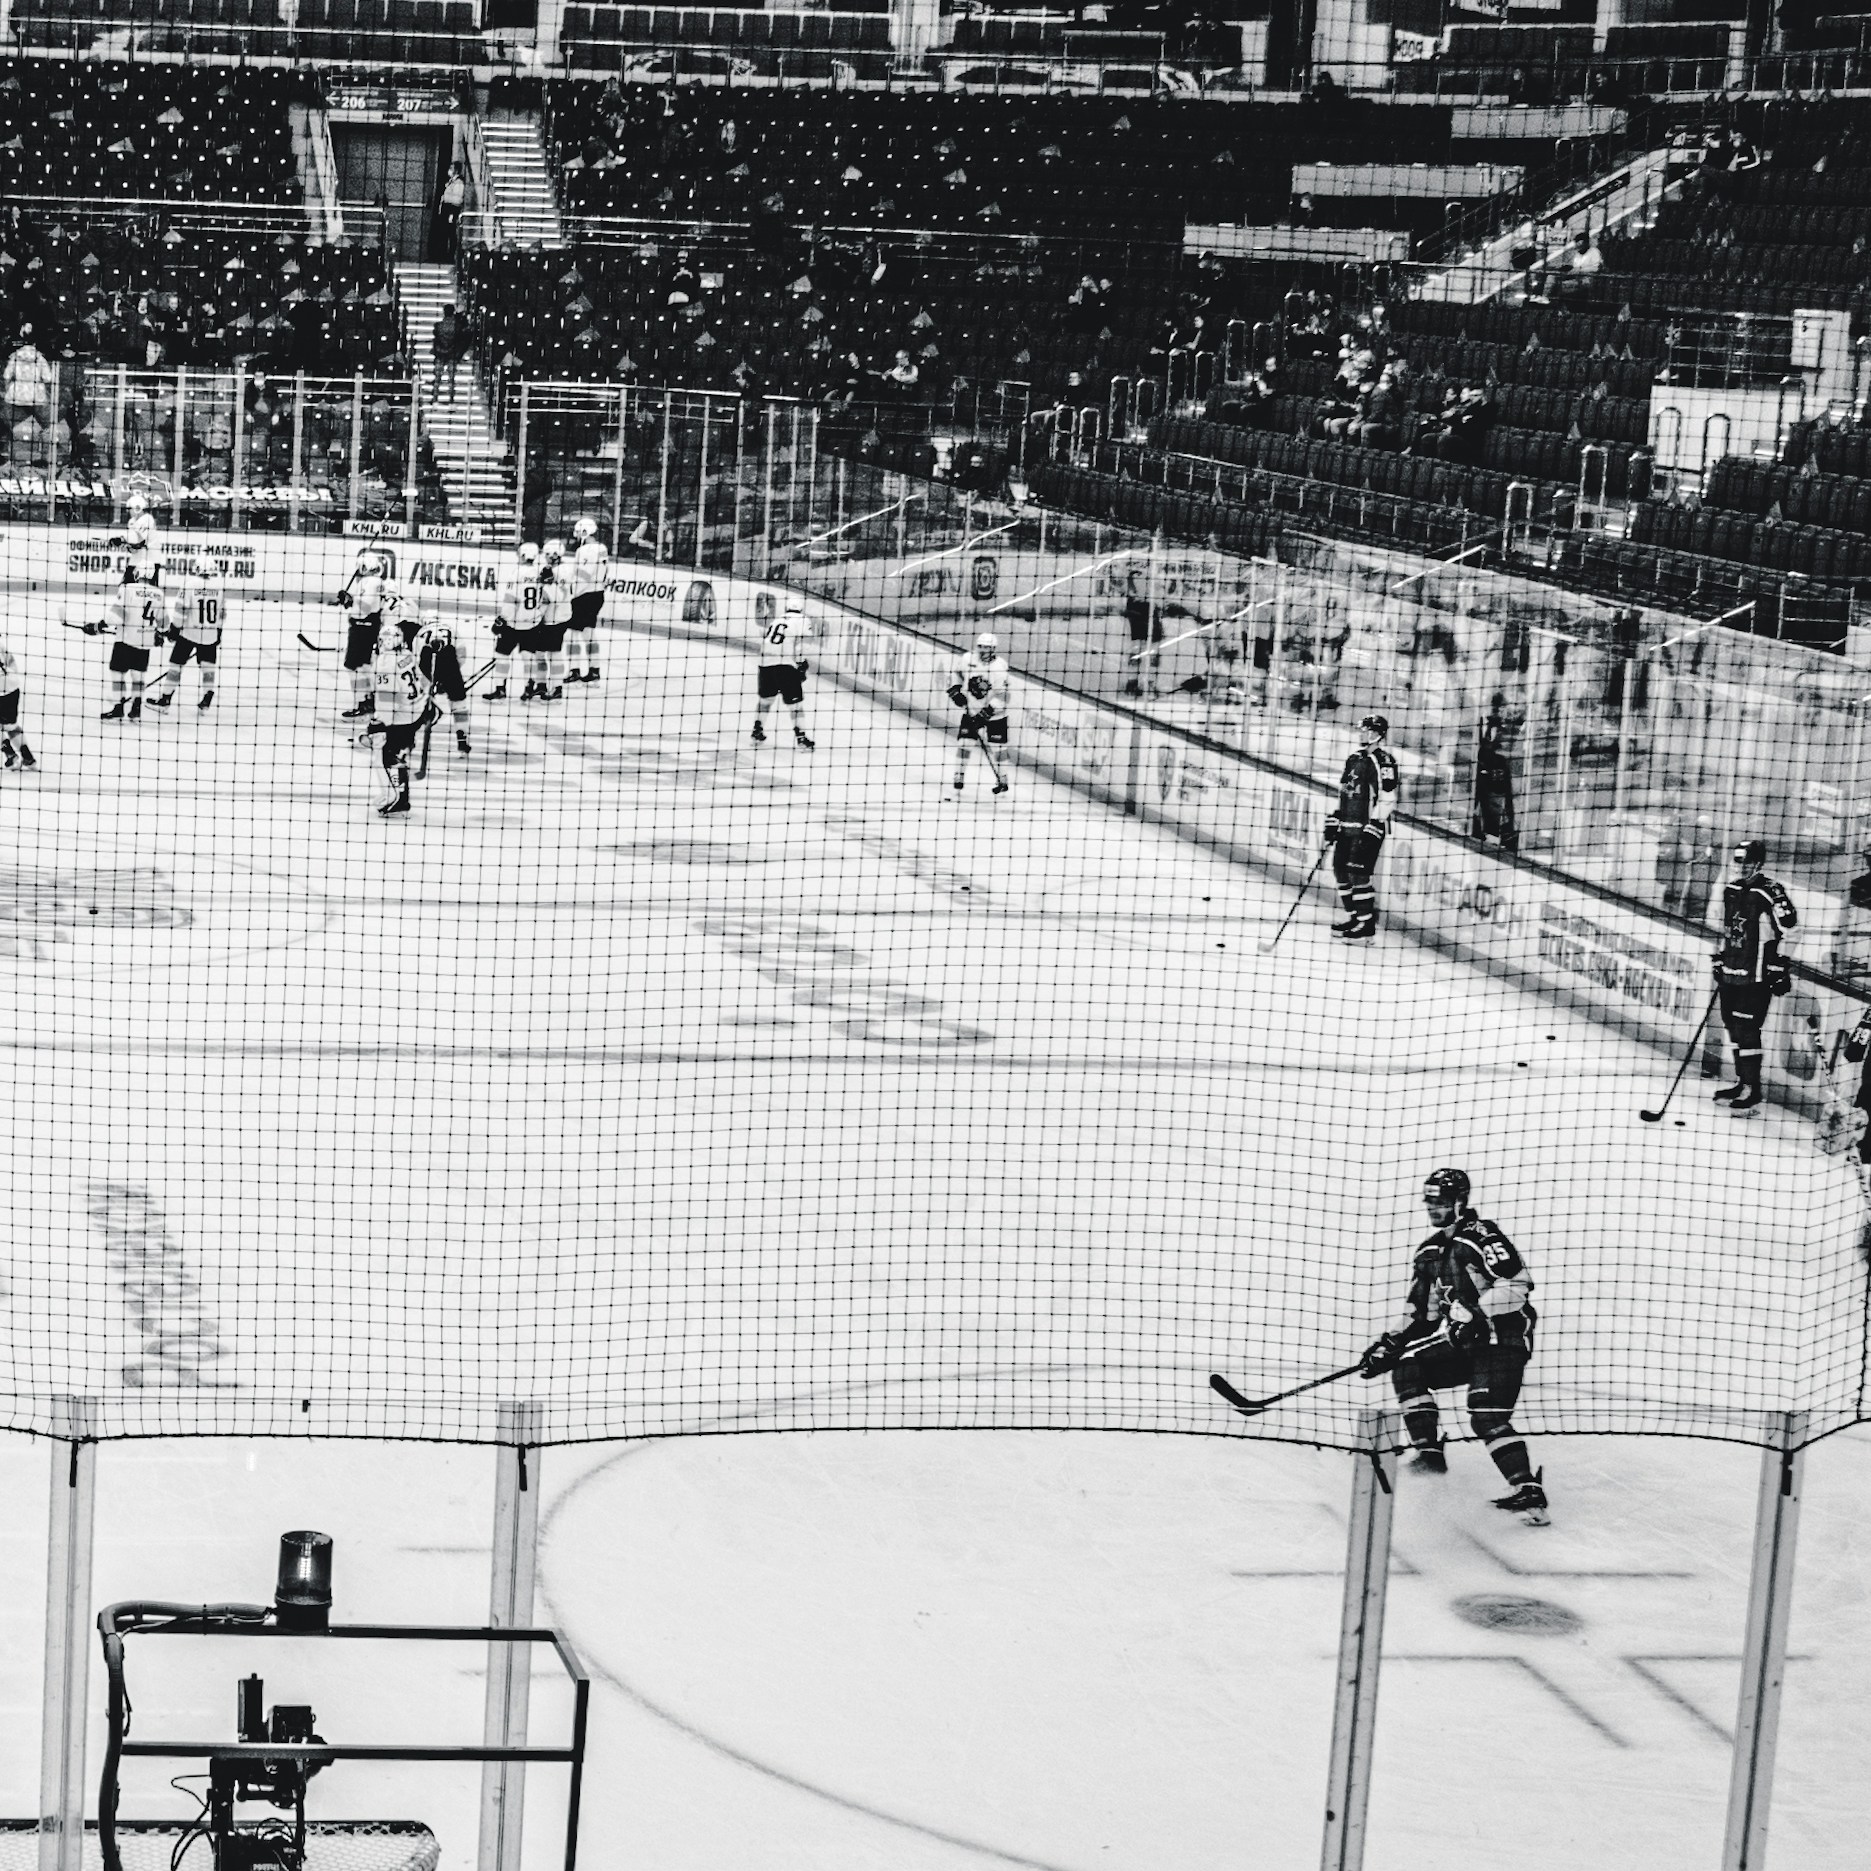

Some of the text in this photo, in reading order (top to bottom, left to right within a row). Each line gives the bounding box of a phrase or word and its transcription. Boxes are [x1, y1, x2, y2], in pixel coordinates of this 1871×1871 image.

[341, 96, 422, 111] 206 207
[180, 485, 333, 502] МОСКВЫ
[352, 522, 400, 535] KHL.RU
[426, 528, 474, 541] KHL.RU
[142, 600, 155, 626] 4
[197, 598, 217, 624] 10
